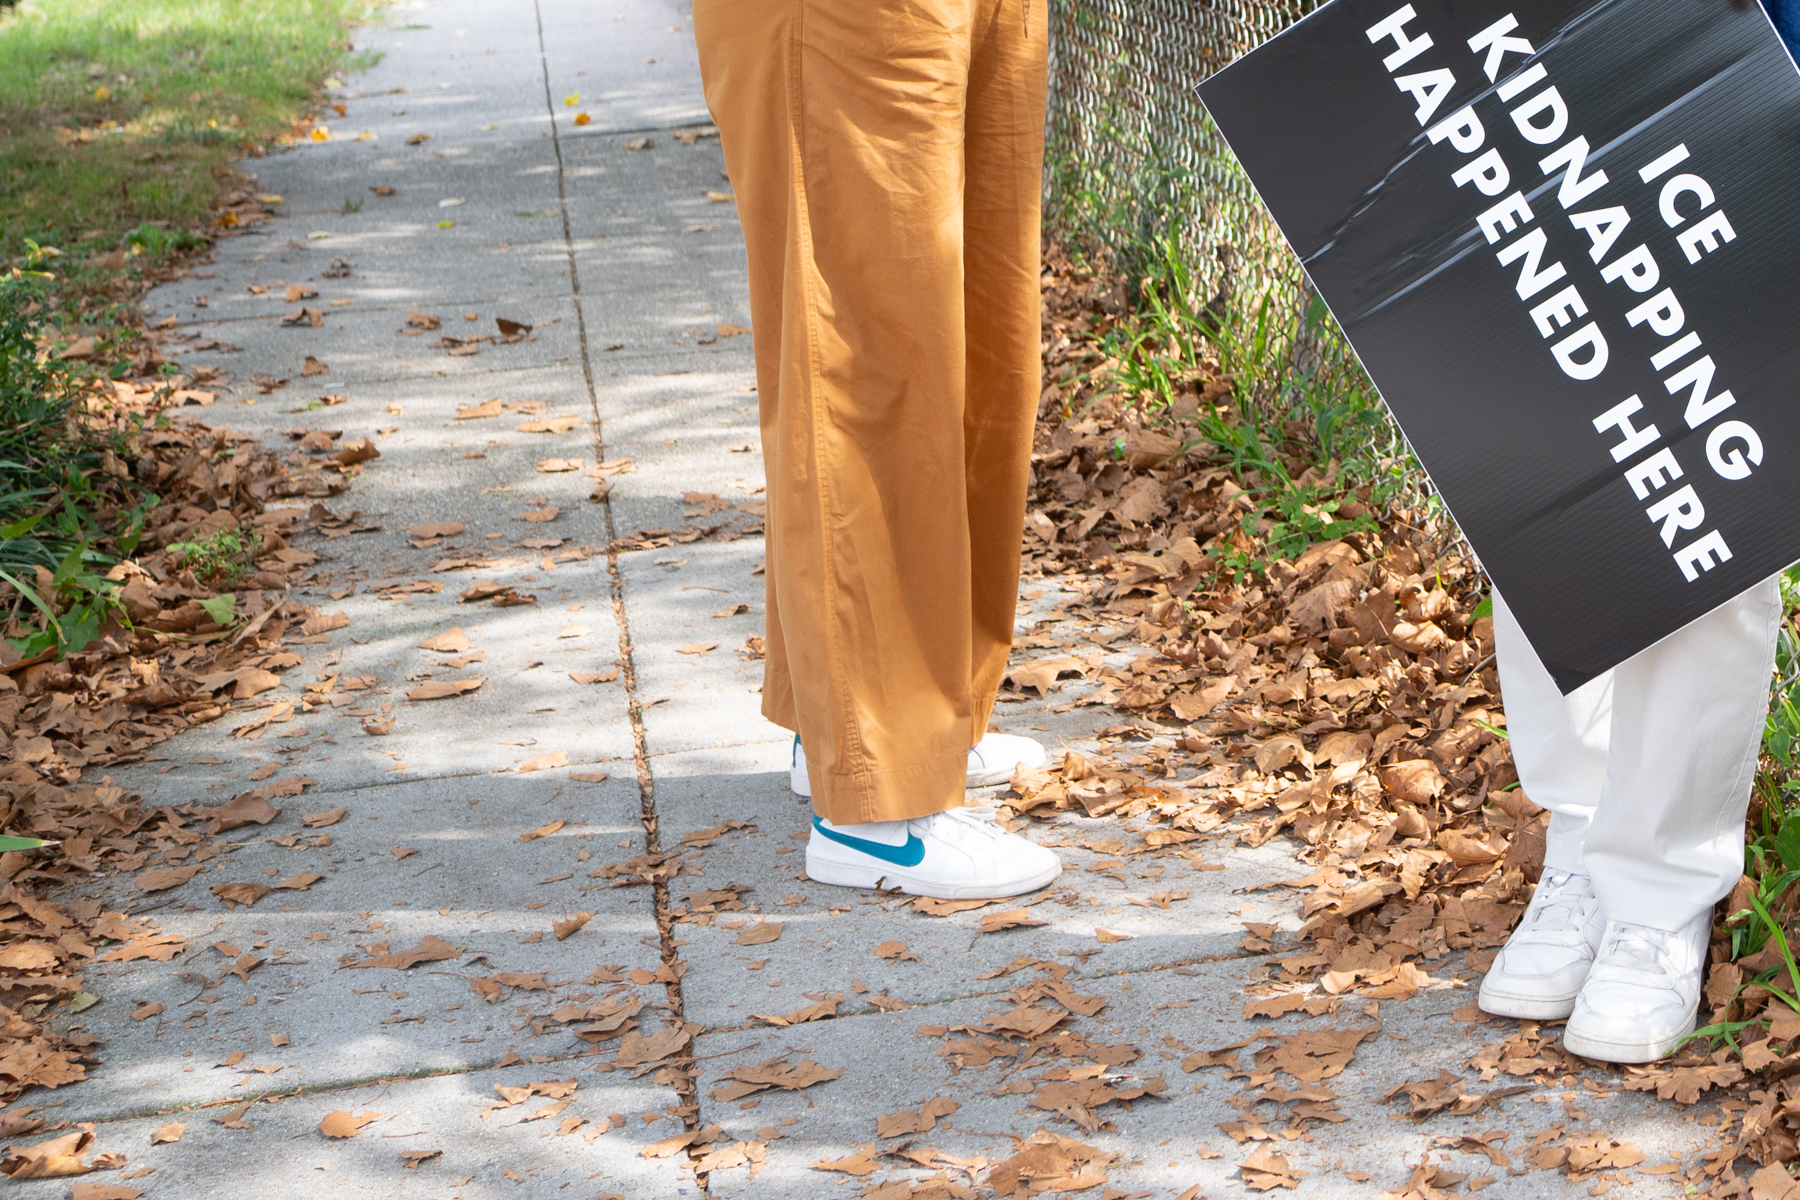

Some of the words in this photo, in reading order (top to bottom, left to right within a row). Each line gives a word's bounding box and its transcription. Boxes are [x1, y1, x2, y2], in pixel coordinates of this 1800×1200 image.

[1365, 3, 1610, 382] HAPPENED
[1592, 393, 1734, 583] HERE
[1466, 12, 1765, 481] KIDNAPPING
[1637, 142, 1738, 266] ICE
